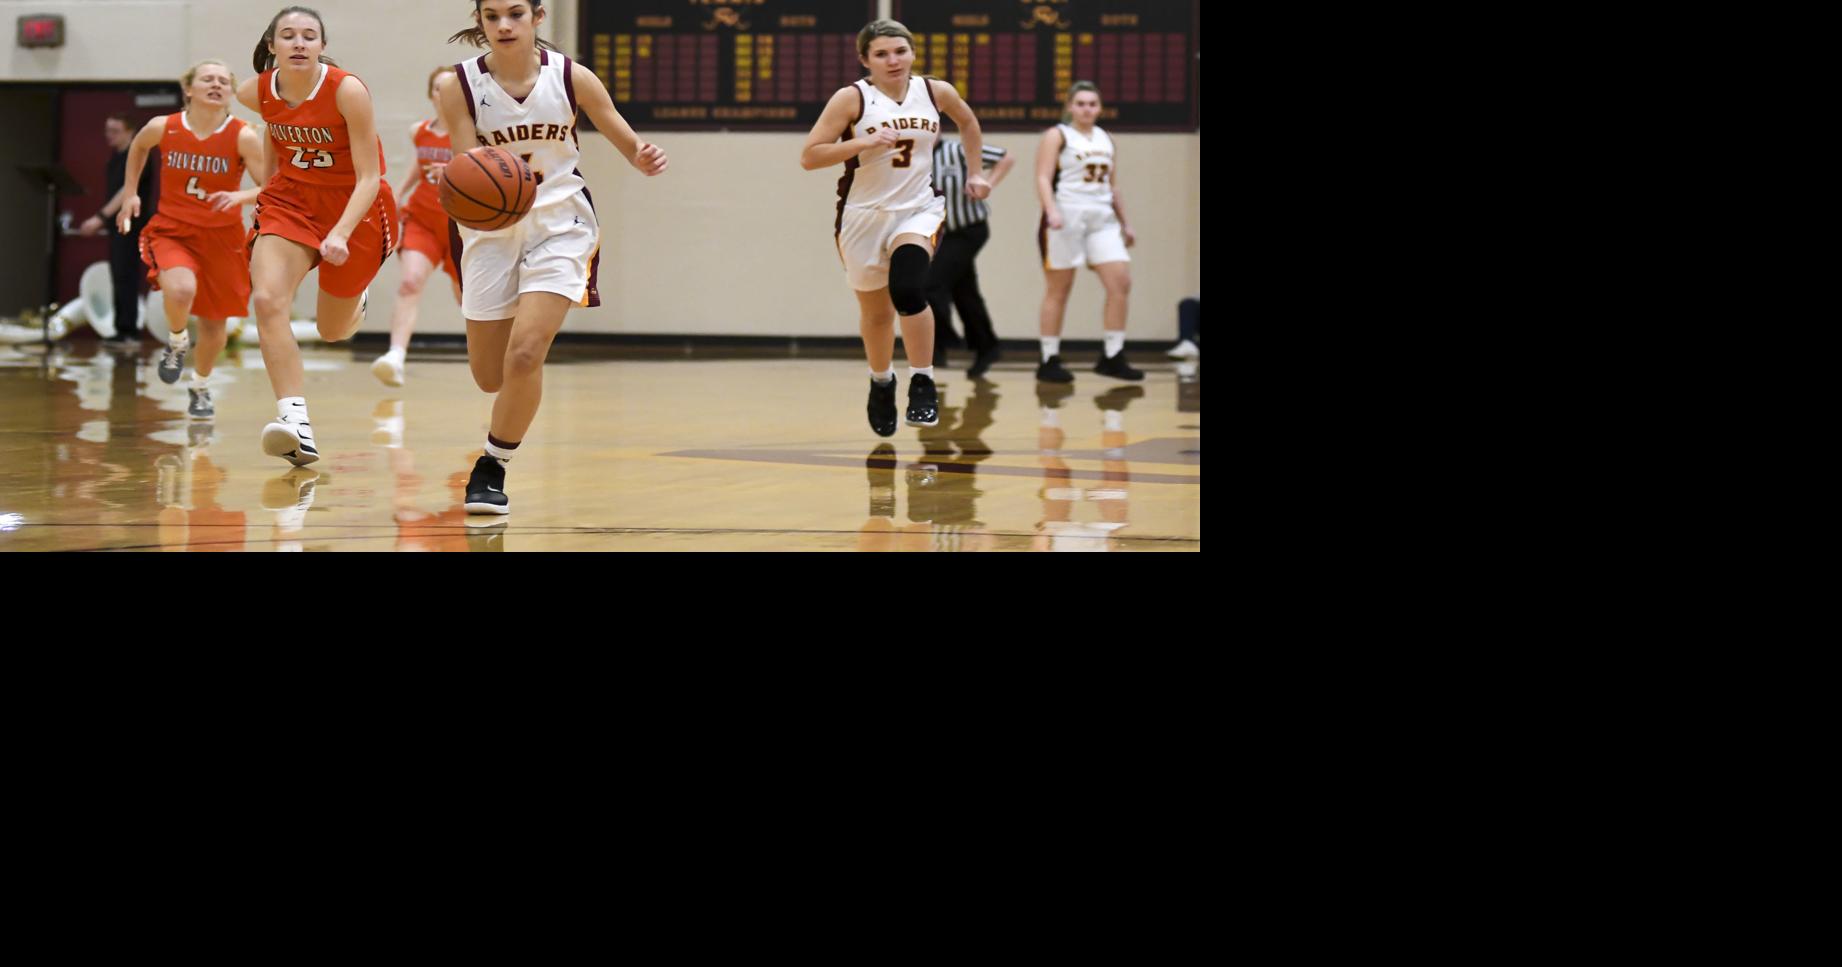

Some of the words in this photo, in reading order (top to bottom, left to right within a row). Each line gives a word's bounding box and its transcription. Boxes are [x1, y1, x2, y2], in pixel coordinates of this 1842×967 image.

[476, 123, 568, 147] RAIDERS
[167, 151, 229, 174] SILVERTON
[285, 145, 335, 170] 23
[892, 138, 914, 168] 3
[1084, 163, 1109, 183] 32
[185, 176, 207, 200] 4
